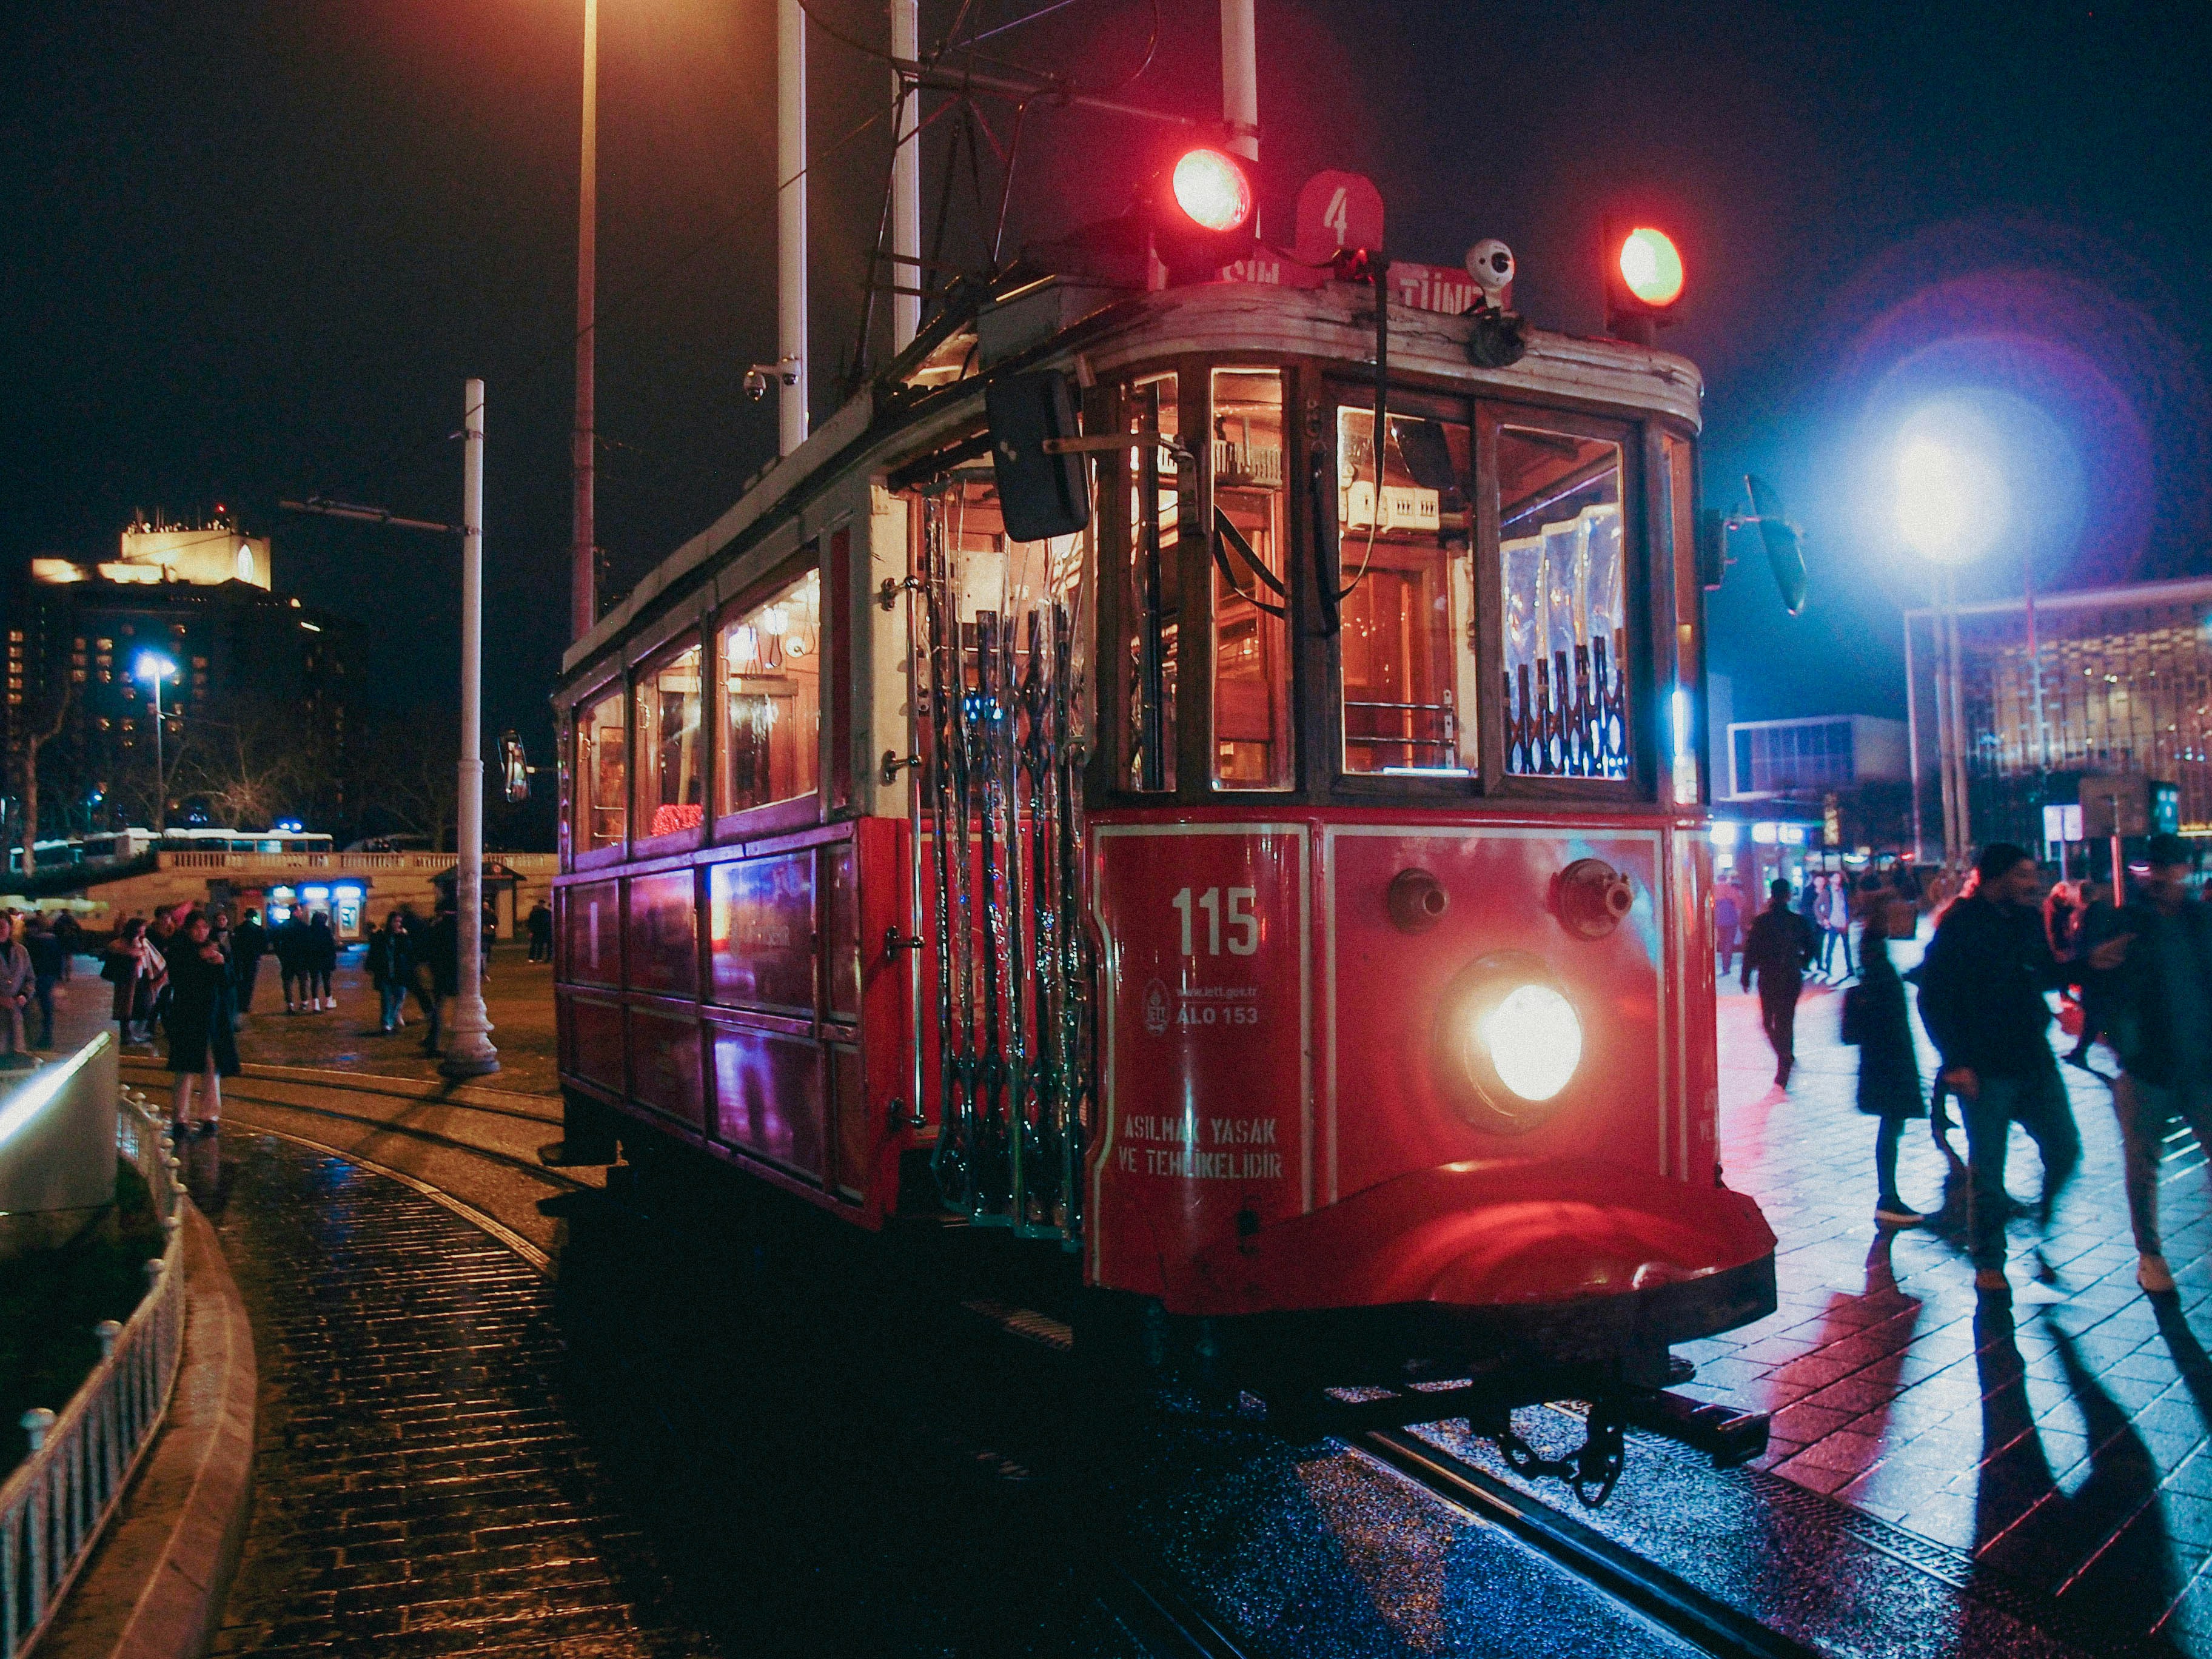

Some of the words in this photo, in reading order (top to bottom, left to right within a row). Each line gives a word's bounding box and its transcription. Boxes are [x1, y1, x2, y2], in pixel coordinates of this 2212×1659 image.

[1324, 187, 1347, 246] 4
[1172, 887, 1258, 956] 115
[1176, 1007, 1216, 1025] ALO
[1222, 1007, 1258, 1025] 153
[1211, 1118, 1276, 1145] YASAK
[1118, 1146, 1138, 1173] VE
